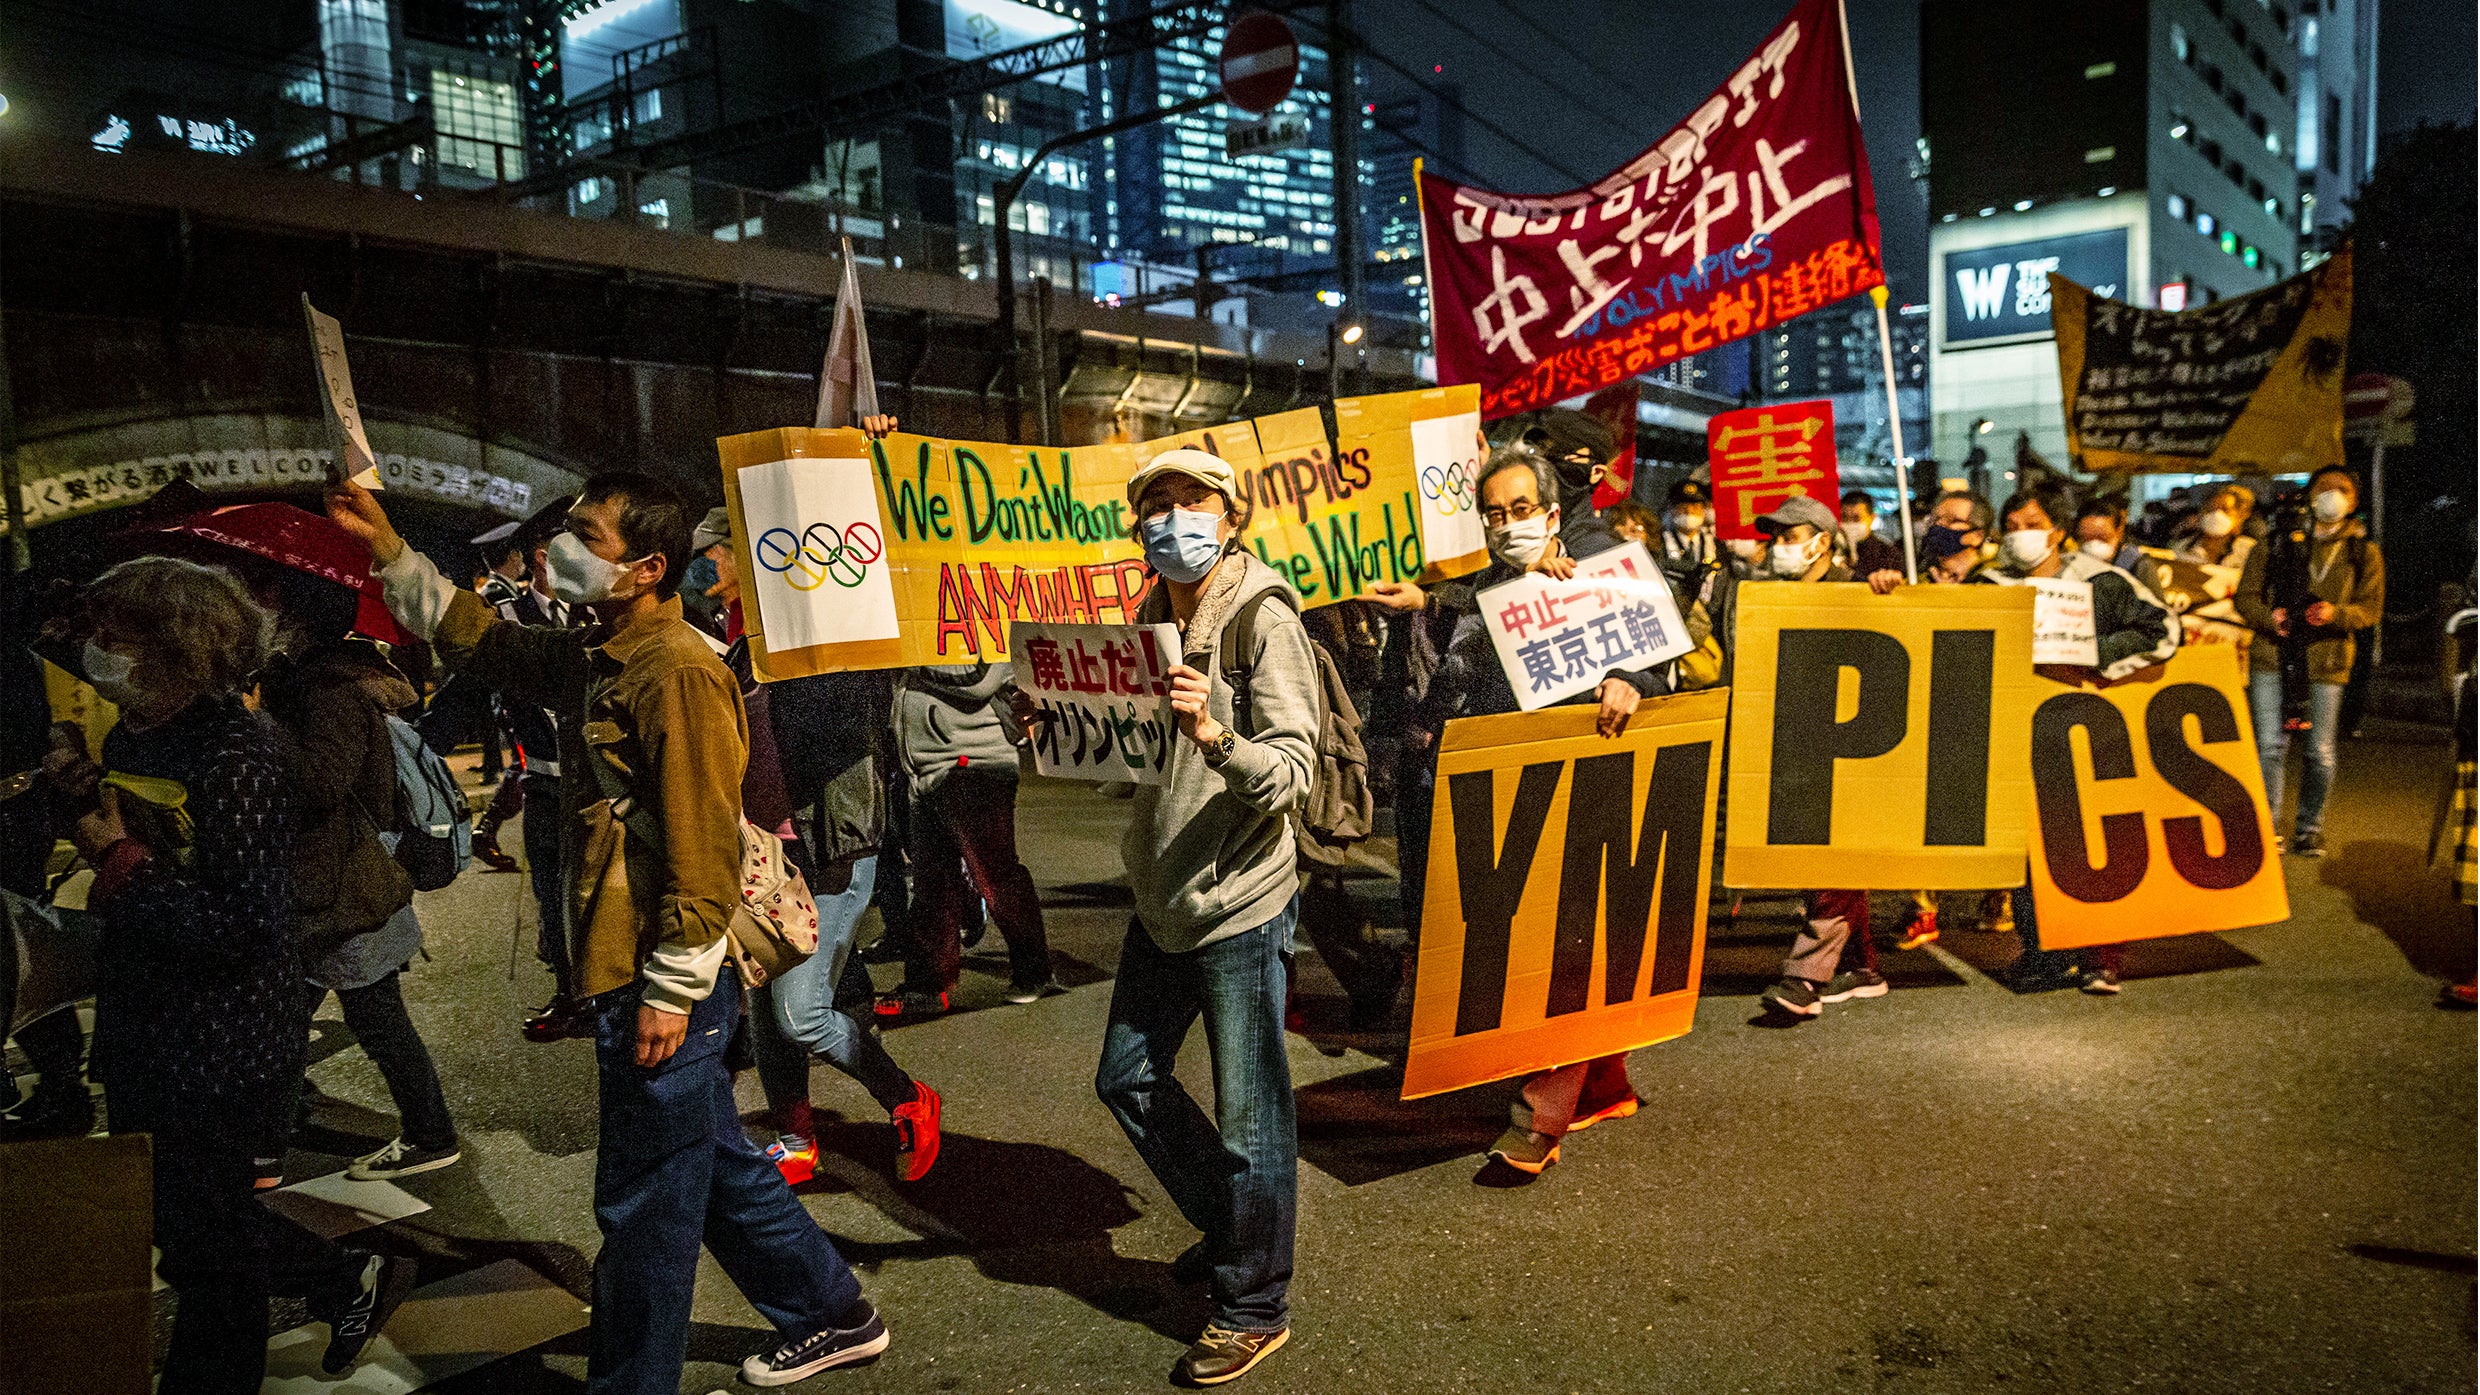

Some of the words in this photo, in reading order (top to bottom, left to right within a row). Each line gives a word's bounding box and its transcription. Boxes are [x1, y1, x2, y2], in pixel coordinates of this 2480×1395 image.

[1955, 262, 2012, 322] W
[871, 439, 955, 543] We
[953, 446, 1053, 545] Don't
[1028, 450, 1134, 546] Want
[1713, 414, 1825, 527] 害
[937, 561, 1150, 656] ANYWHER
[1254, 536, 1320, 599] he
[1307, 491, 1427, 601] World
[1026, 630, 1169, 697] 廃止だ!
[1516, 599, 1669, 694] 東京五輪
[1035, 697, 1178, 774] オリンピッ
[1766, 628, 1996, 845] PI
[2031, 682, 2264, 904] CS
[1448, 740, 1713, 1037] YM
